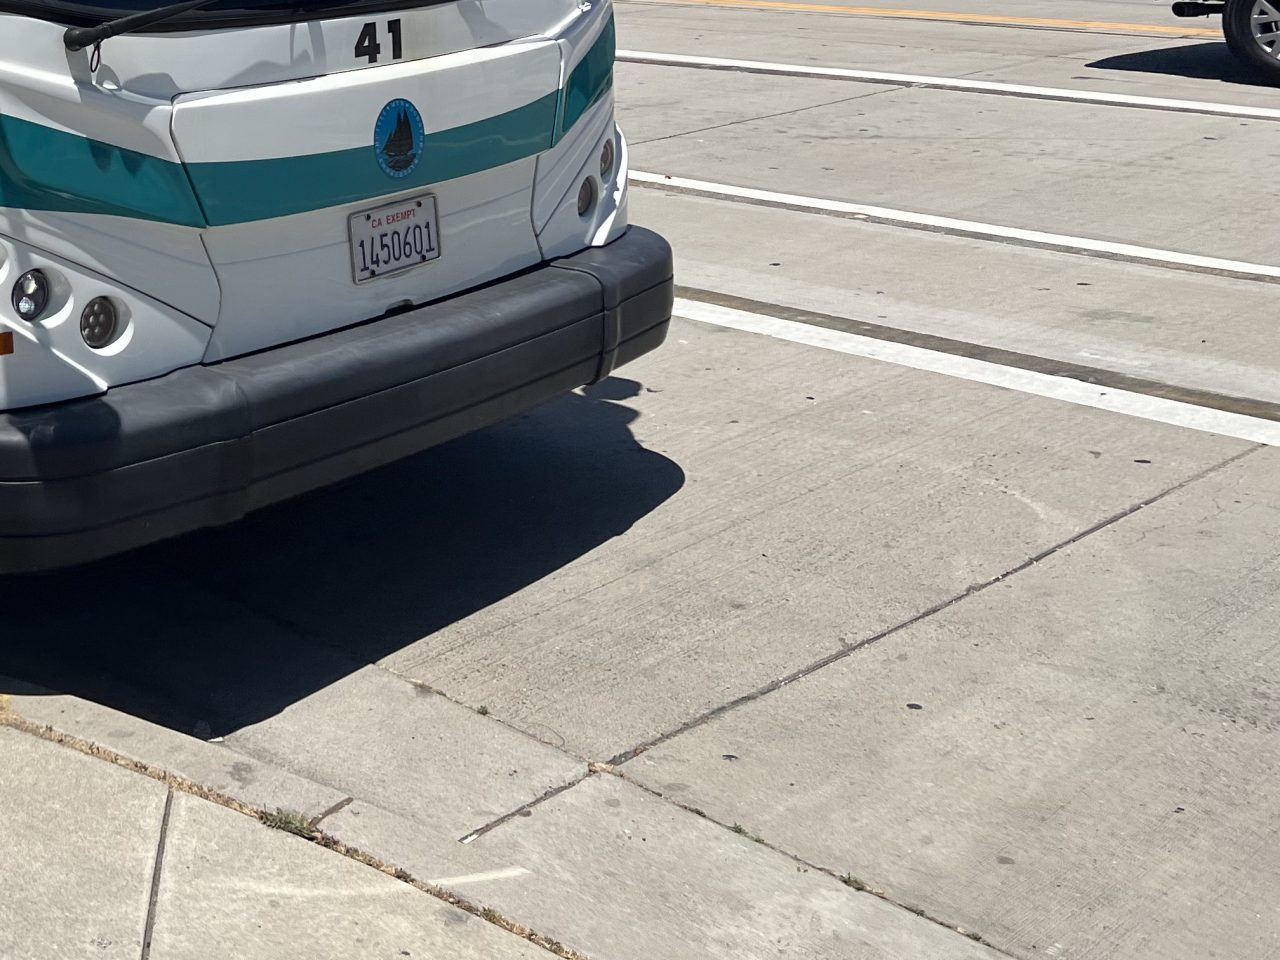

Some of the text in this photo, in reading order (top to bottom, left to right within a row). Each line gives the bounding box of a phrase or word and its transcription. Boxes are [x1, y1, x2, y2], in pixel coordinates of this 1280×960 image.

[354, 18, 403, 65] 41
[371, 208, 417, 229] CA EXEMPT
[358, 220, 436, 273] 1450601
